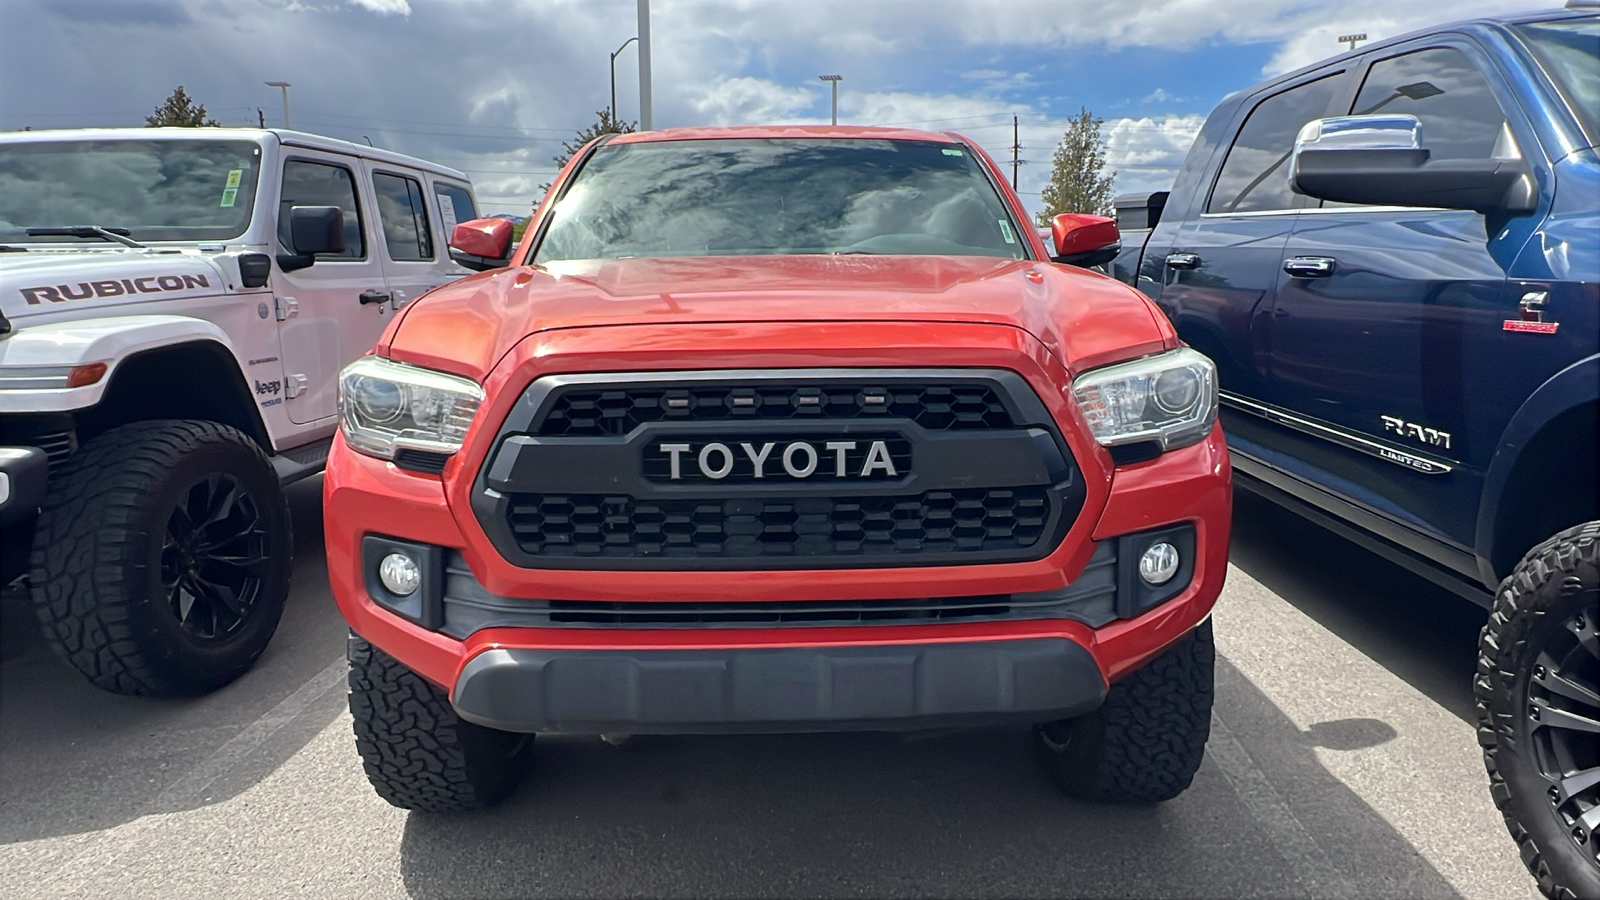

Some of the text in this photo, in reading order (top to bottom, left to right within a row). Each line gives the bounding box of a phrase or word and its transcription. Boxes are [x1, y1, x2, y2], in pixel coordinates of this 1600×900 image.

[18, 274, 210, 305] RUBICON
[255, 379, 281, 395] Jeep
[1380, 414, 1451, 449] RAM
[659, 441, 898, 479] TOYOTA
[1380, 449, 1433, 471] LIMITED
